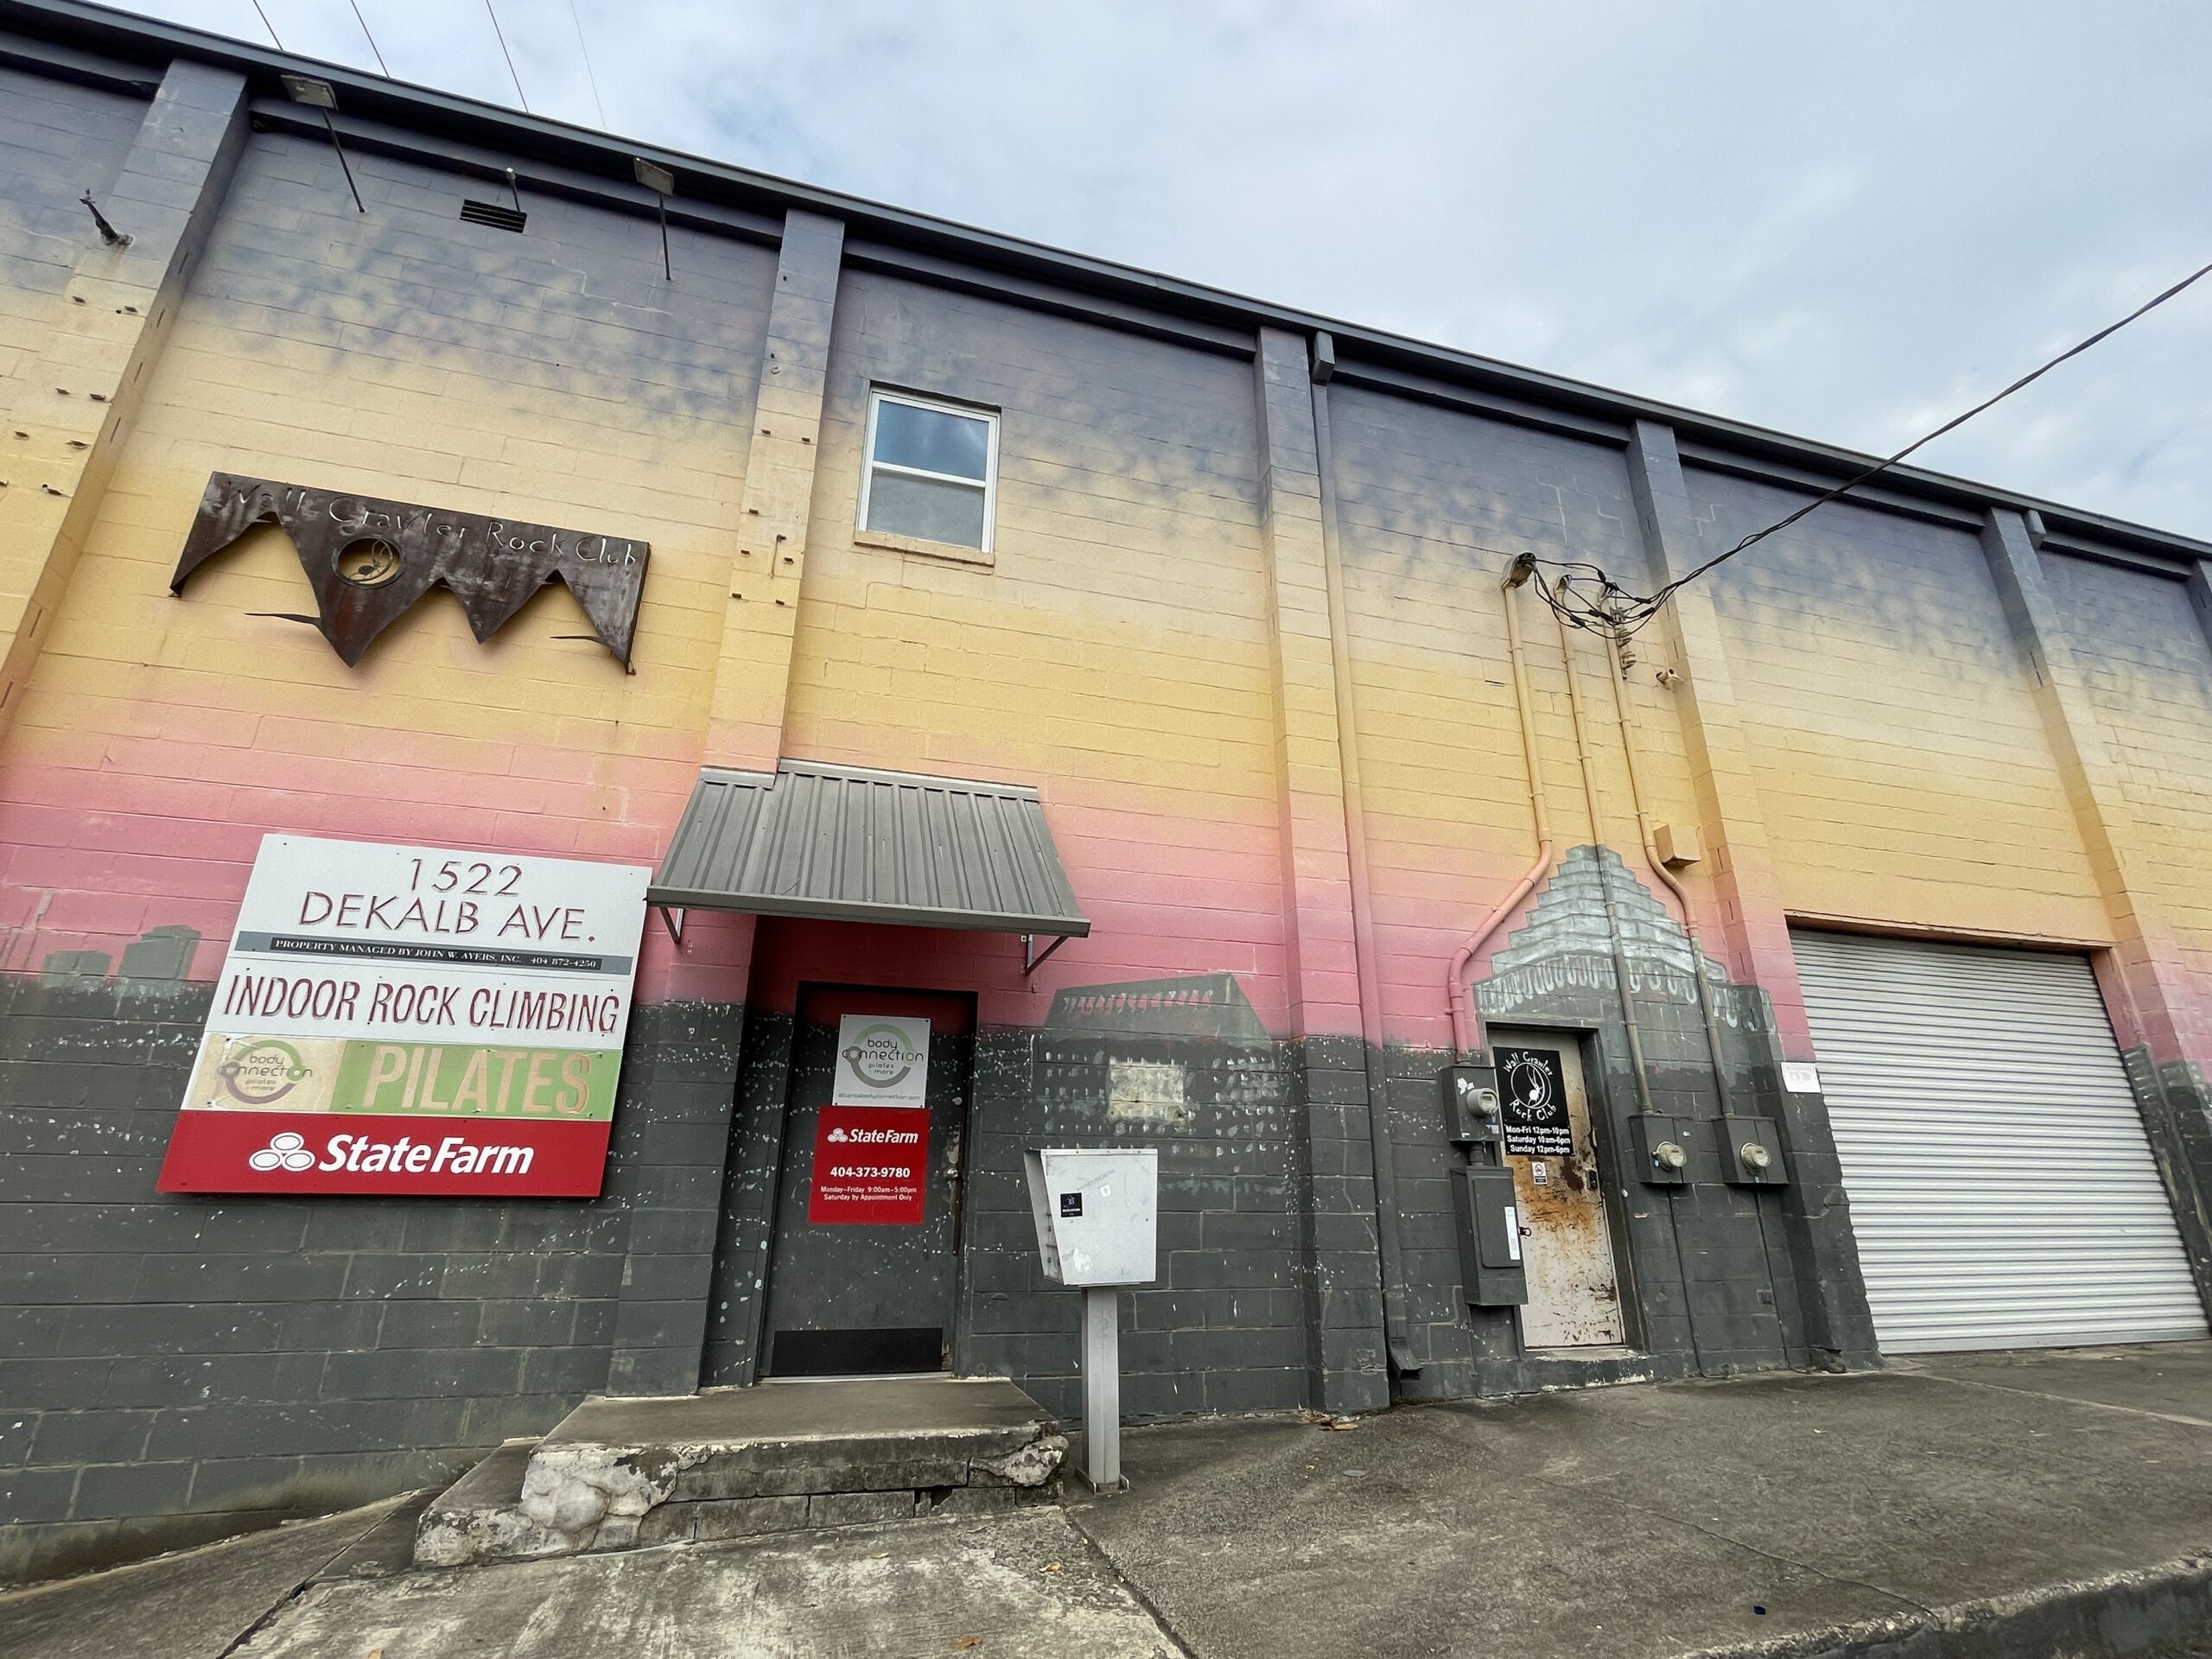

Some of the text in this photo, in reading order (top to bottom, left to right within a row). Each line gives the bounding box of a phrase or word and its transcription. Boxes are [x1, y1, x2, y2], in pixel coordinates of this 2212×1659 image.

[328, 496, 467, 539] Crawler
[486, 520, 564, 556] Rock
[575, 536, 635, 566] Club
[410, 858, 524, 898] 1522
[298, 891, 596, 944] DEKALB AVE.
[275, 939, 337, 951] PROPERTY
[339, 944, 396, 955] MANAGED
[398, 947, 413, 956] BY
[414, 949, 444, 958] JOHN
[461, 952, 498, 962] AYERS,
[500, 955, 521, 963] INC.
[551, 958, 596, 968] 872-4250
[223, 973, 620, 1034] INDOOR ROCK CLIMBING
[842, 1049, 925, 1062] connection
[868, 1038, 898, 1052] body
[249, 1053, 285, 1067] body
[1503, 1051, 1553, 1077] Wall Crawler
[362, 1044, 593, 1114] PILATES
[1509, 1098, 1557, 1122] Rock Club
[1505, 1125, 1570, 1136] Mon-Fri 12pm-10pm
[1506, 1135, 1571, 1146] Saturday 10am-6pm
[1510, 1144, 1571, 1154] Sunday 12pm-6pm
[830, 1166, 911, 1178] 404-373-9780
